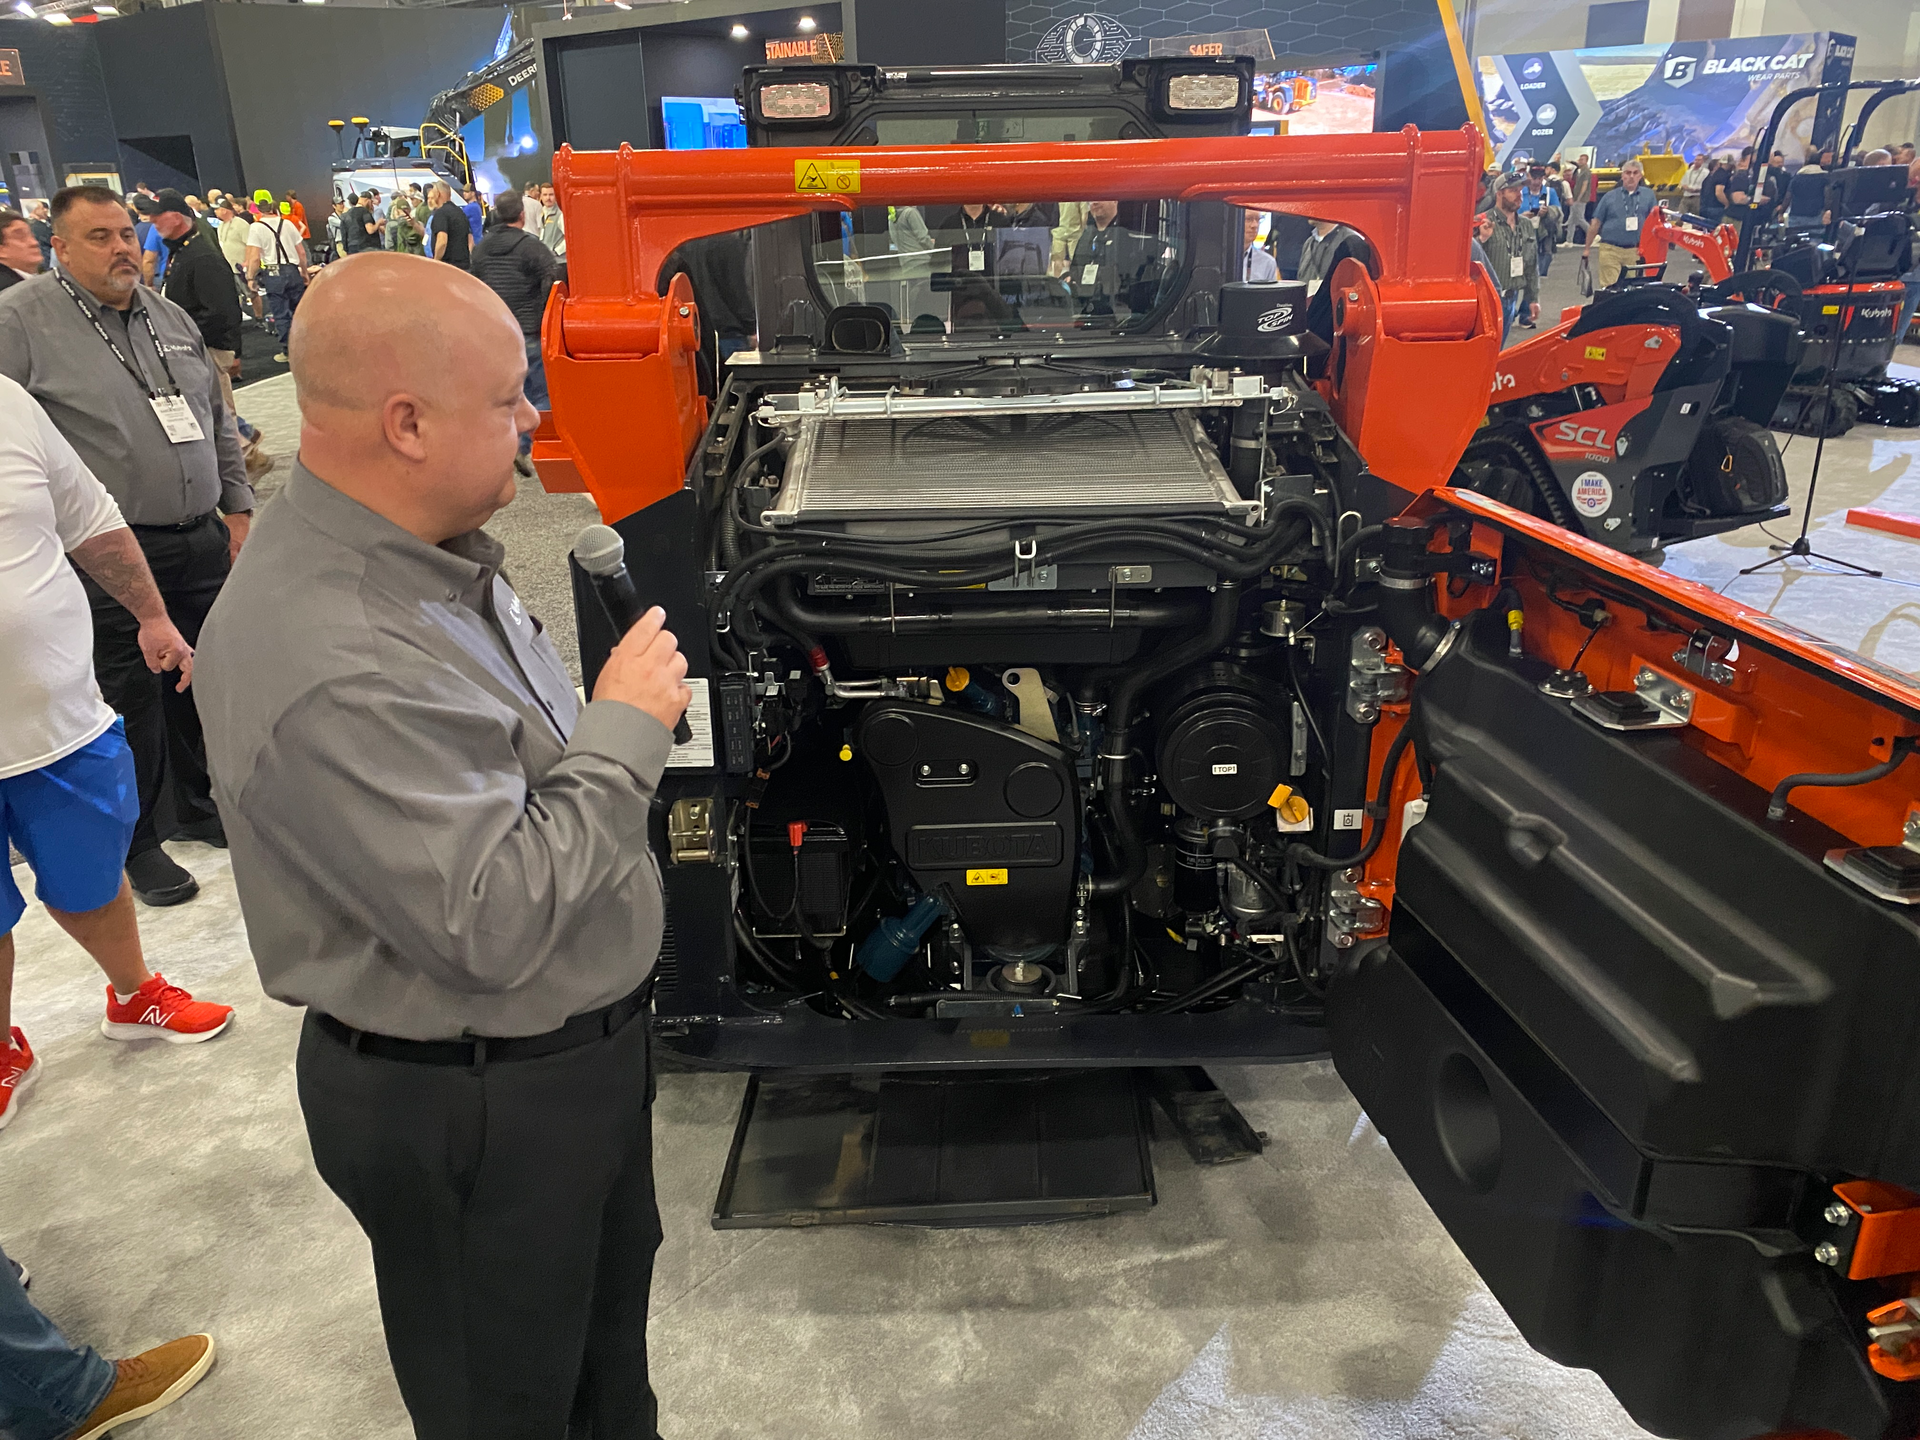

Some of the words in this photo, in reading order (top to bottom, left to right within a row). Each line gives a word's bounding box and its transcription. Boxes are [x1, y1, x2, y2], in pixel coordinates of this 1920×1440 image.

[765, 40, 818, 59] STAINABLE
[1189, 42, 1223, 56] SAFER
[1702, 54, 1771, 75] BLACK
[1770, 53, 1815, 71] CAT
[1747, 72, 1773, 82] WEAR
[1773, 71, 1801, 80] PARTS
[1520, 82, 1546, 90] LOADER
[1531, 128, 1554, 136] DOZER
[1861, 307, 1892, 318] Kubota
[1555, 421, 1612, 450] SCL
[1584, 479, 1603, 487] MAKE
[1577, 488, 1606, 496] AMERICA
[918, 834, 1053, 860] KUBOTA
